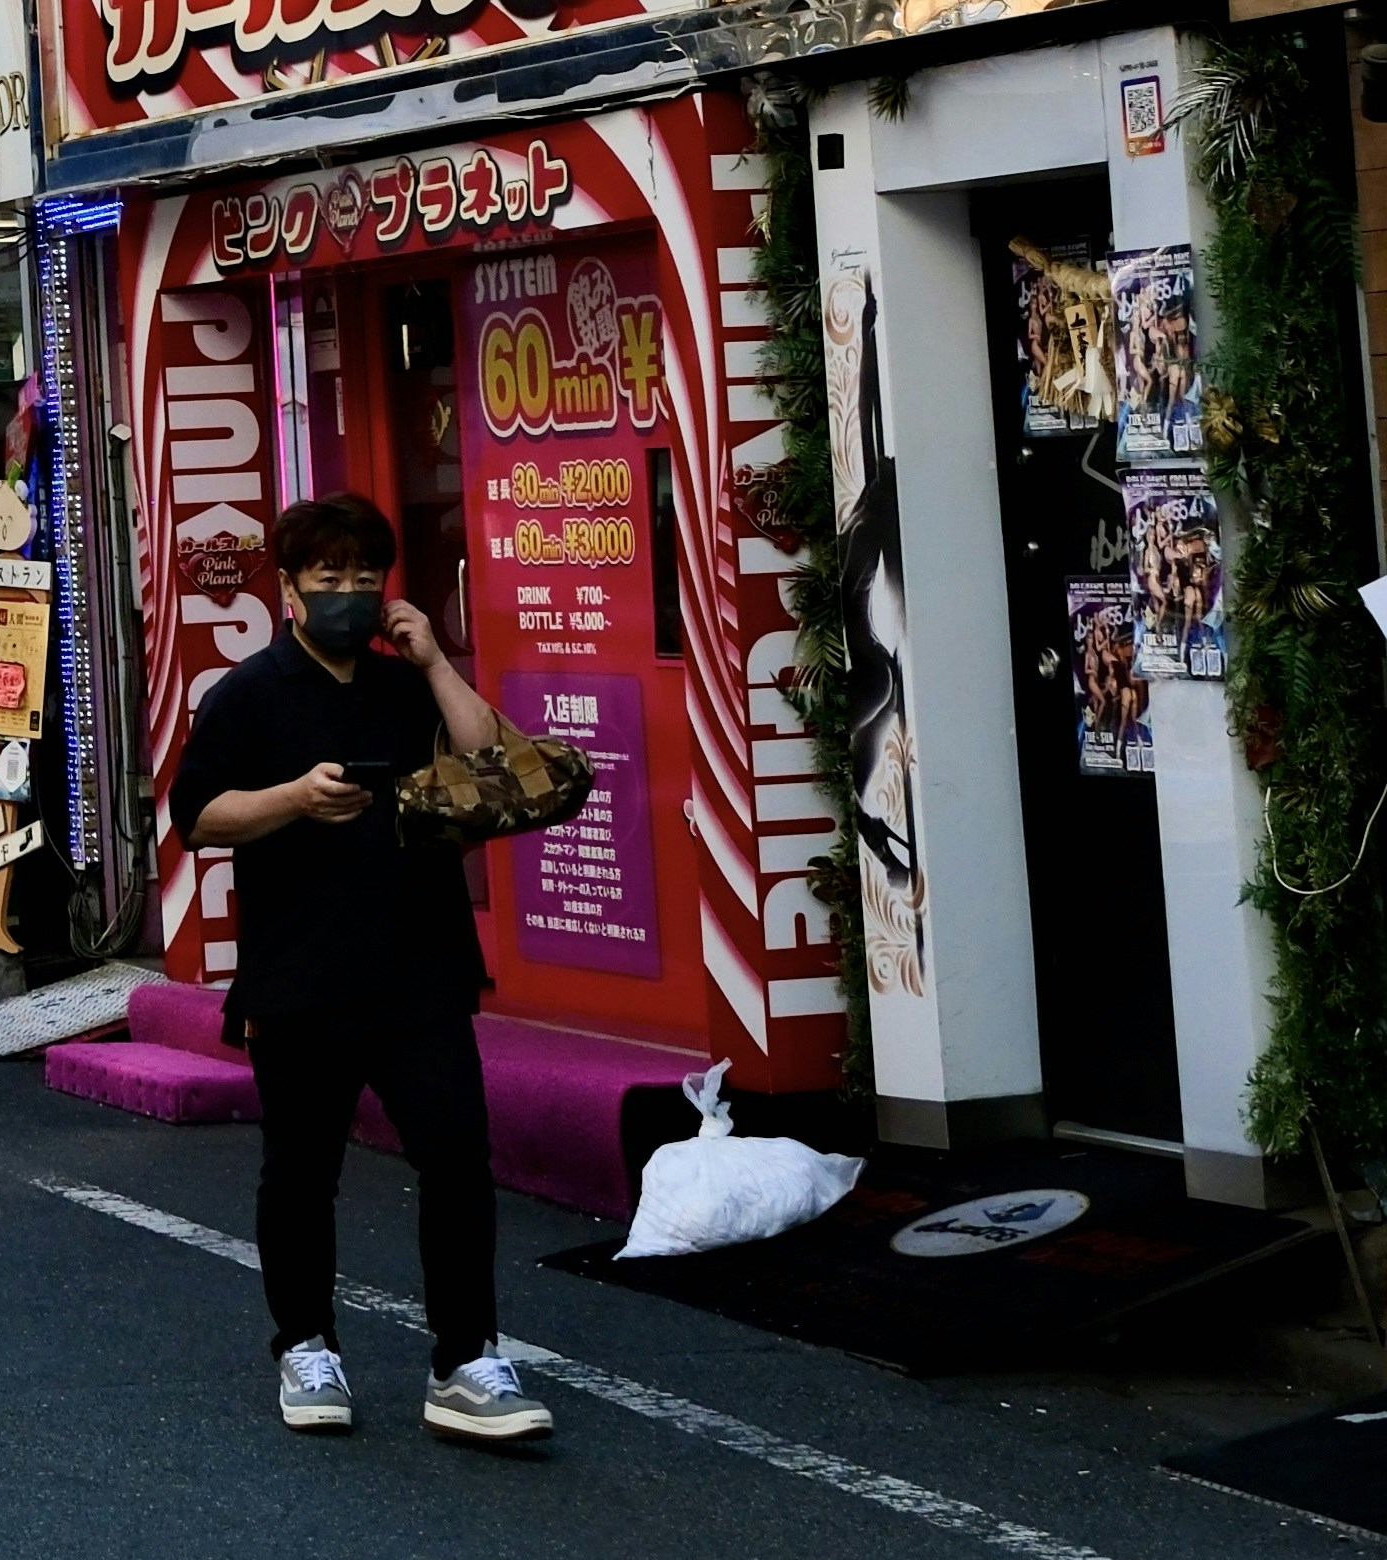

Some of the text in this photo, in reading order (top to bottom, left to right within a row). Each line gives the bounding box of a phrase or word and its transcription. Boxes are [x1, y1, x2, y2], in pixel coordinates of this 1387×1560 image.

[211, 139, 569, 267] ピンク プラネット
[473, 255, 557, 305] SYSTEM
[517, 586, 552, 605] DRINK
[519, 611, 564, 631] BOTTLE
[543, 693, 600, 725] 入店制限
